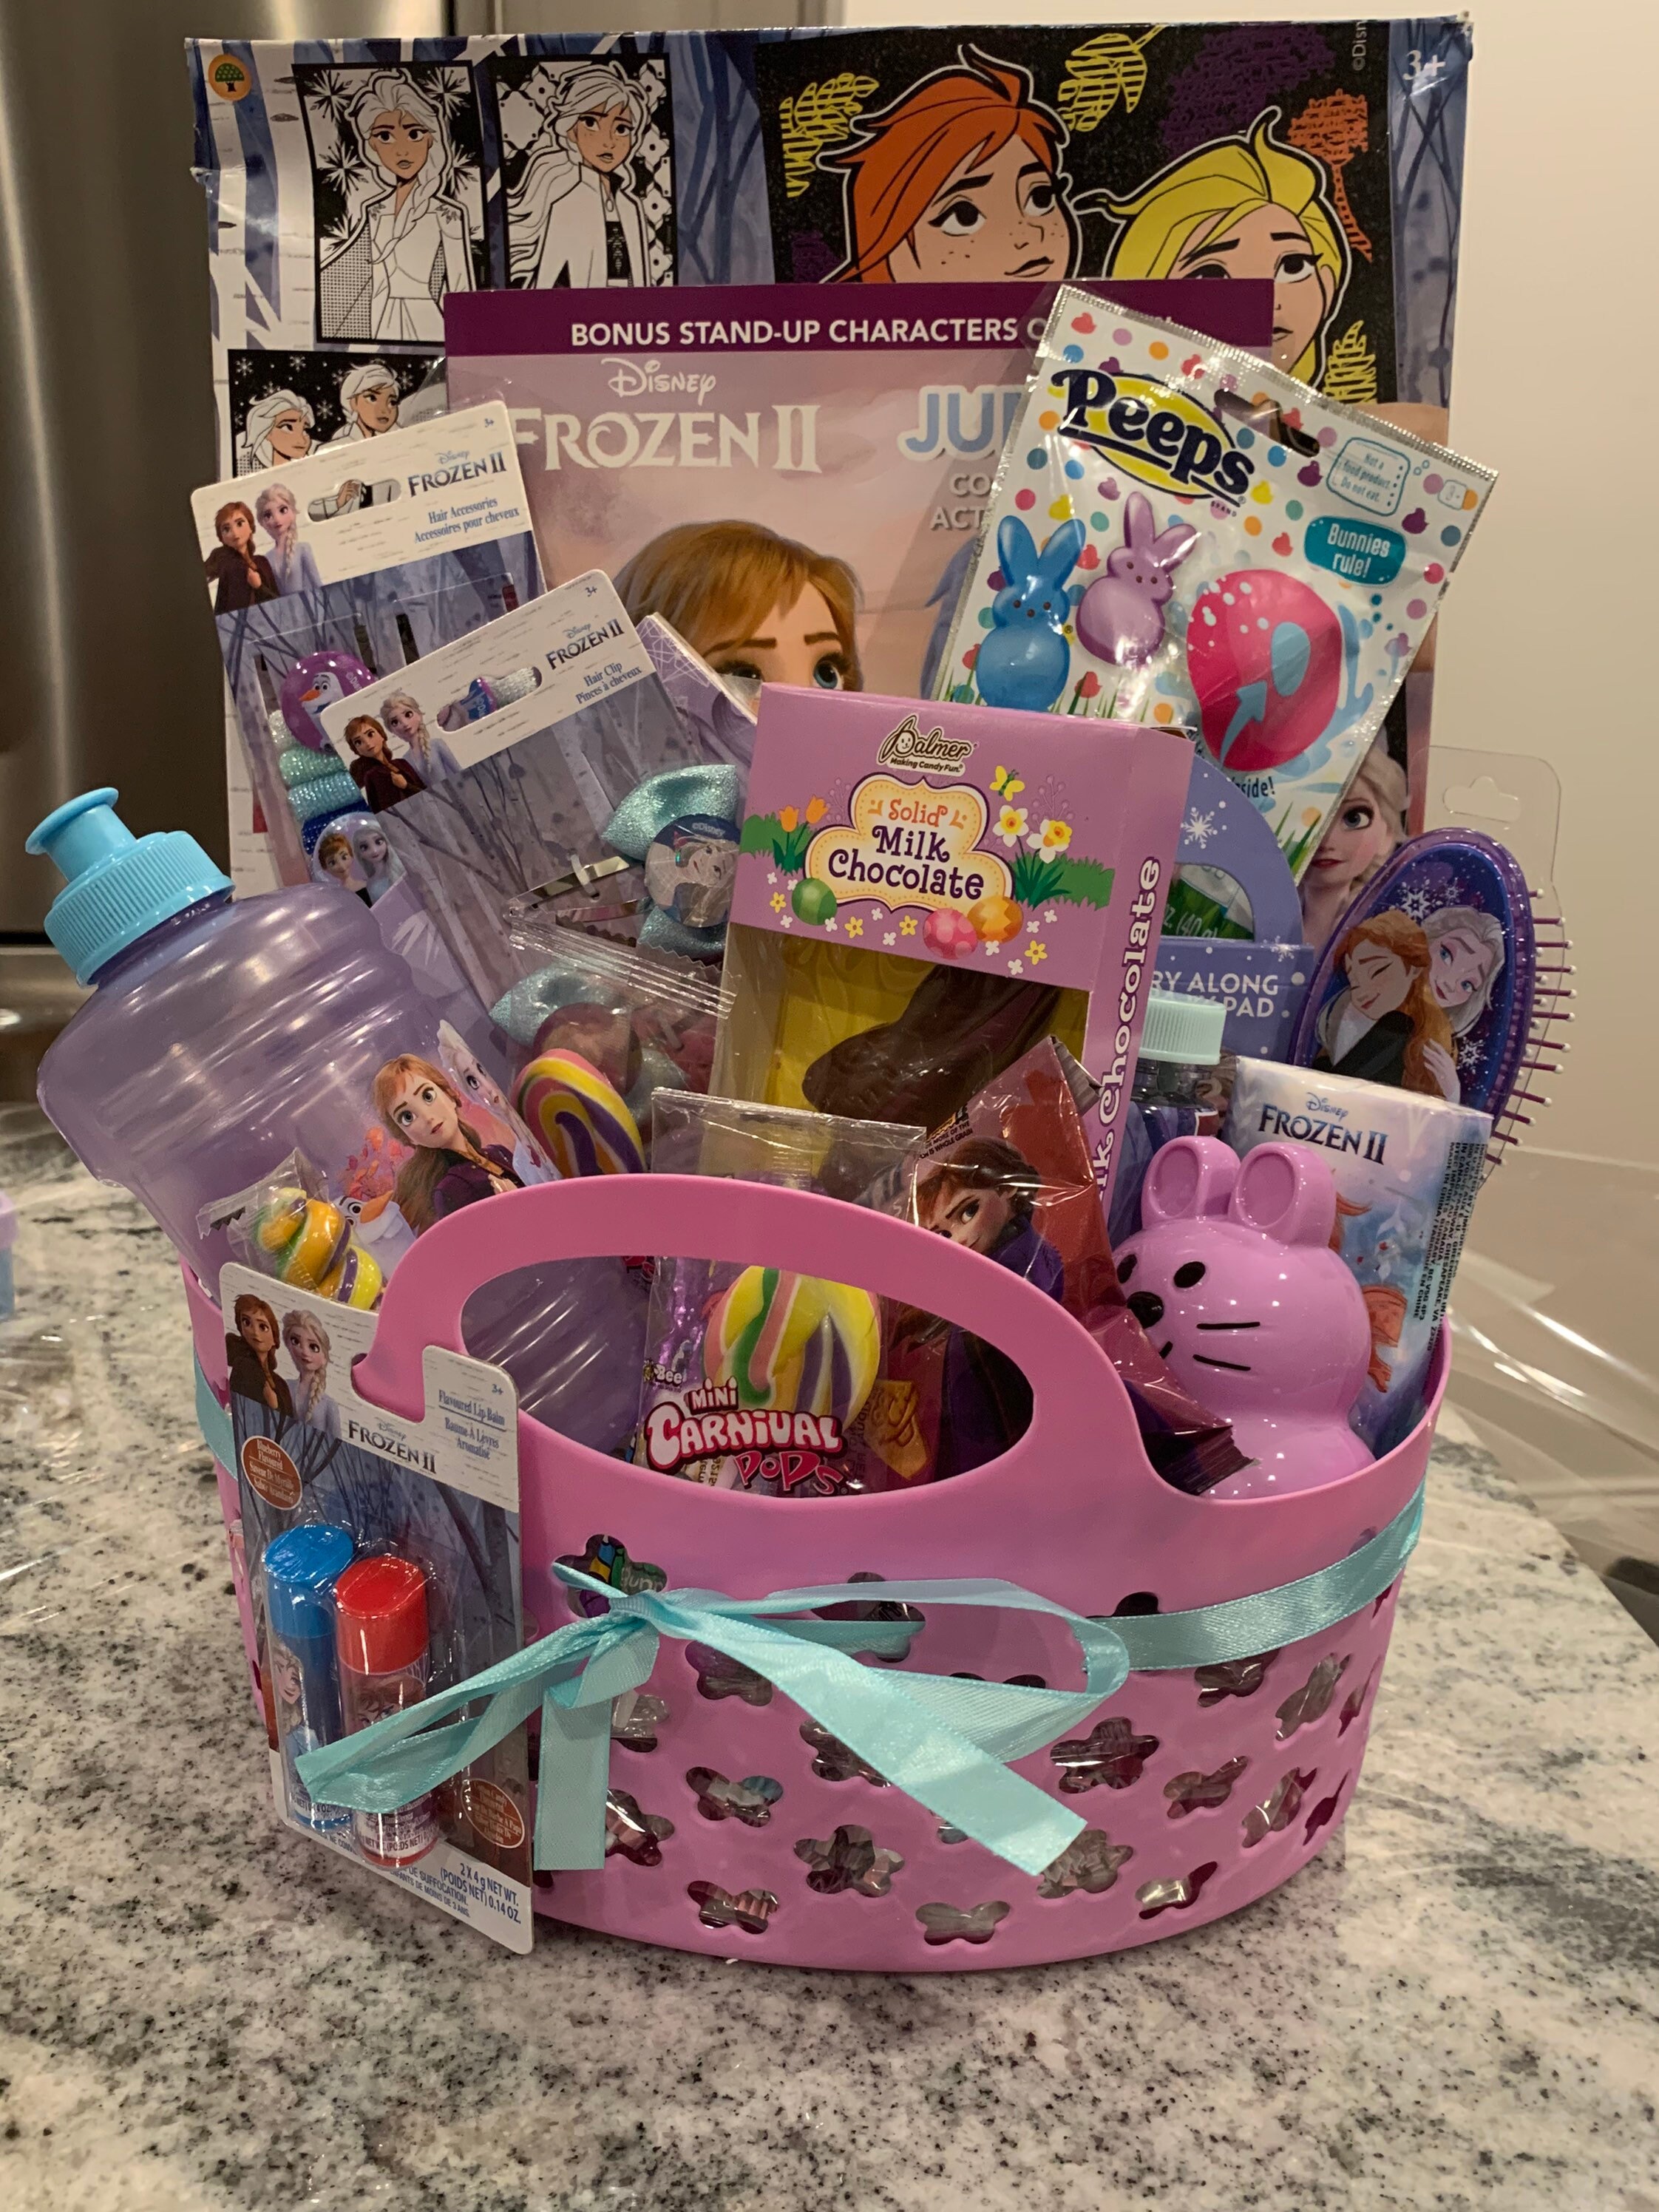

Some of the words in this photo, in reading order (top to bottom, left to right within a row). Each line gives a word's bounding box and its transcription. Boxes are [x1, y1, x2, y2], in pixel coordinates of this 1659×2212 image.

[1403, 50, 1446, 80] 3+
[571, 323, 670, 346] BONUS
[679, 321, 820, 345] STAND-UP
[829, 319, 1018, 343] CHARACTERS
[601, 358, 716, 405] Disney
[507, 407, 762, 472] FROZEN
[772, 404, 822, 474] II
[1051, 369, 1255, 497] Peeps
[407, 459, 487, 498] FROZEN
[489, 452, 507, 473] II
[1343, 460, 1359, 476] food
[1340, 477, 1351, 489] Do
[1352, 482, 1366, 494] not
[414, 523, 461, 543] Accessoires
[462, 518, 484, 535] pour
[484, 507, 520, 528] cheveux
[429, 509, 448, 523] Hair
[449, 497, 498, 519] Accessories
[1328, 523, 1391, 559] Bunnies
[1332, 550, 1371, 577] rule!
[586, 586, 597, 597] 3+
[546, 626, 608, 670] FROZEN
[607, 618, 625, 638] II
[575, 685, 602, 705] Pinces
[610, 665, 642, 688] cheveux
[583, 670, 603, 688] Hair
[603, 661, 623, 678] Clip
[879, 716, 971, 762] Palmer
[890, 758, 918, 769] Making
[919, 761, 944, 772] Candy
[889, 799, 947, 828] Solid
[872, 825, 951, 863] Milk
[828, 849, 984, 900] Chocolate
[1099, 857, 1161, 1124] Chocolate
[1187, 971, 1278, 997] ALONG
[1224, 996, 1275, 1018] PAD
[1306, 1092, 1349, 1122] Disney
[934, 1138, 955, 1152] WHOLE
[954, 1128, 974, 1141] GRAIN
[1258, 1103, 1363, 1153] FROZEN
[1363, 1132, 1389, 1165] II
[1461, 1142, 1467, 1153] IN
[1445, 1141, 1455, 1170] MADE
[1443, 1173, 1449, 1184] IN
[1453, 1156, 1465, 1196] CANADA
[1436, 1187, 1446, 1217] CHINA
[1419, 1274, 1426, 1286] EN
[1427, 1268, 1434, 1281] BC
[1434, 1242, 1451, 1307] CHESAPEAKE,
[1442, 1241, 1458, 1300] GREENBRIER
[1413, 1289, 1423, 1319] CHINE
[1431, 1309, 1439, 1322] VA
[654, 1364, 682, 1385] Bee
[438, 1388, 472, 1414] Flavoured
[473, 1402, 486, 1422] Lip
[486, 1407, 506, 1426] Balm
[444, 1417, 469, 1437] Baume
[347, 1419, 420, 1465] FROZEN
[421, 1451, 438, 1475] II
[409, 1865, 418, 1878] DE
[419, 1870, 469, 1906] SUFFOCATION.
[415, 1882, 424, 1891] DE
[424, 1885, 444, 1902] MOINS
[444, 1896, 452, 1907] DE
[452, 1901, 457, 1910] 3
[441, 1867, 467, 1893] (POIDS
[469, 1883, 487, 1907] NET)
[488, 1895, 506, 1916] 0.14
[506, 1905, 521, 1924] OZ.
[460, 1863, 466, 1876] 2
[467, 1866, 472, 1879] X
[473, 1871, 479, 1883] 4
[480, 1877, 486, 1891] g
[487, 1877, 502, 1897] NET
[503, 1886, 519, 1907] WT.
